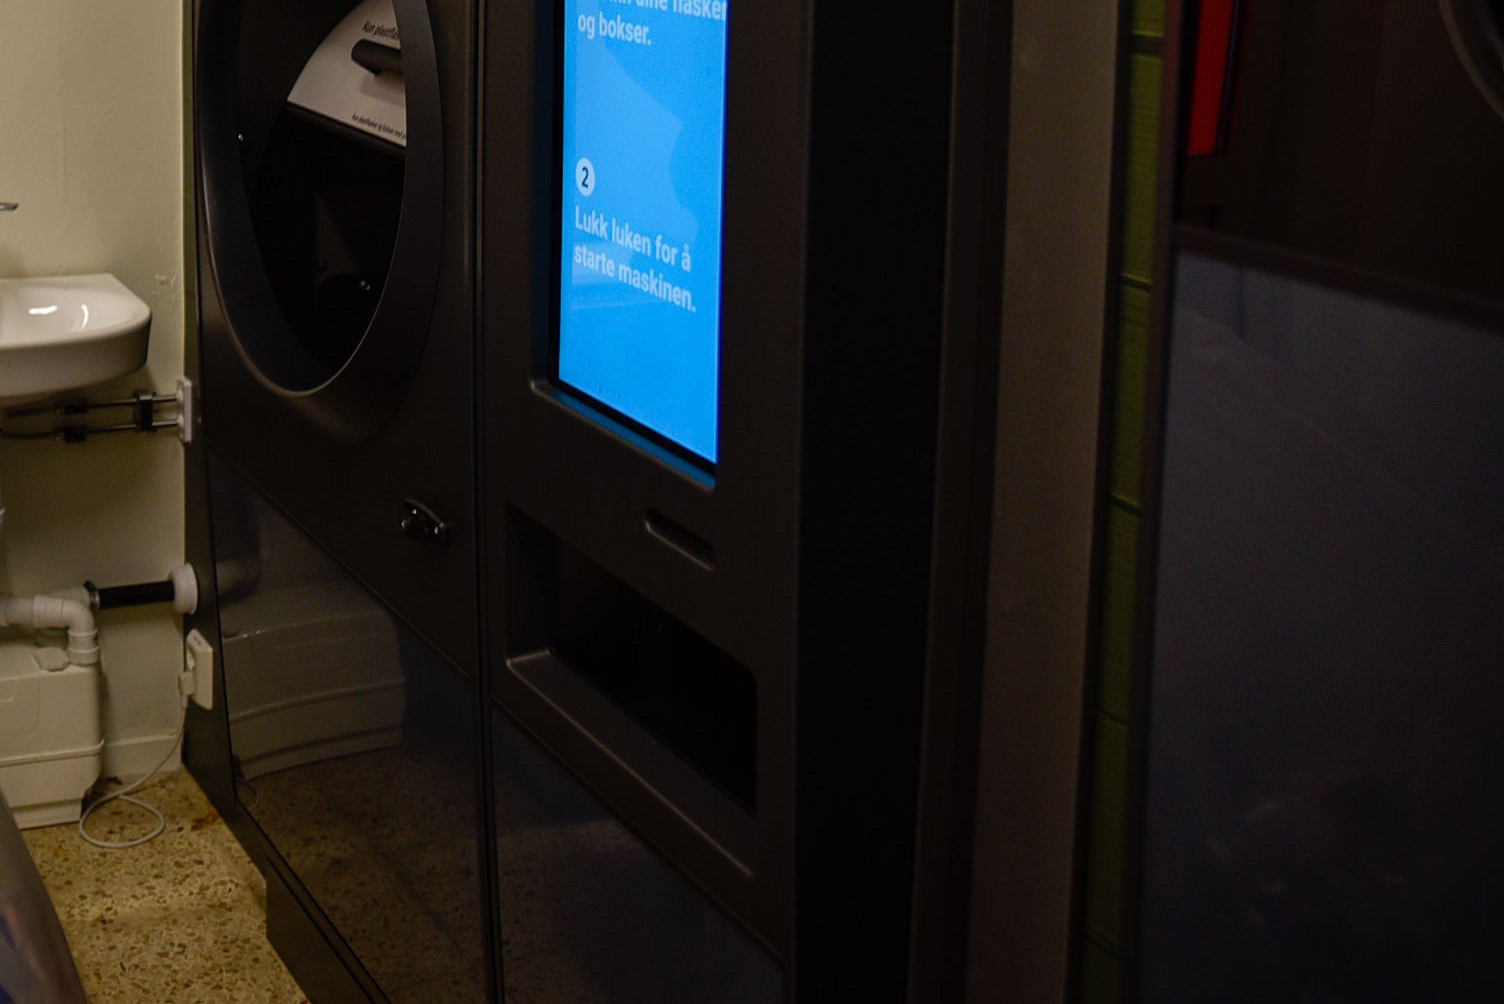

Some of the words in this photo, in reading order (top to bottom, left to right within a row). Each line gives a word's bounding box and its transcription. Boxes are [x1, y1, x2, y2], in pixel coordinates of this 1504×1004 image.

[578, 13, 595, 41] og
[599, 11, 652, 46] bokser.
[581, 166, 589, 188] 2
[575, 206, 608, 241] Lukk
[612, 218, 651, 257] luken
[655, 234, 678, 266] for
[682, 243, 691, 272] å
[574, 244, 615, 277] starte
[618, 263, 696, 312] maskinen.
